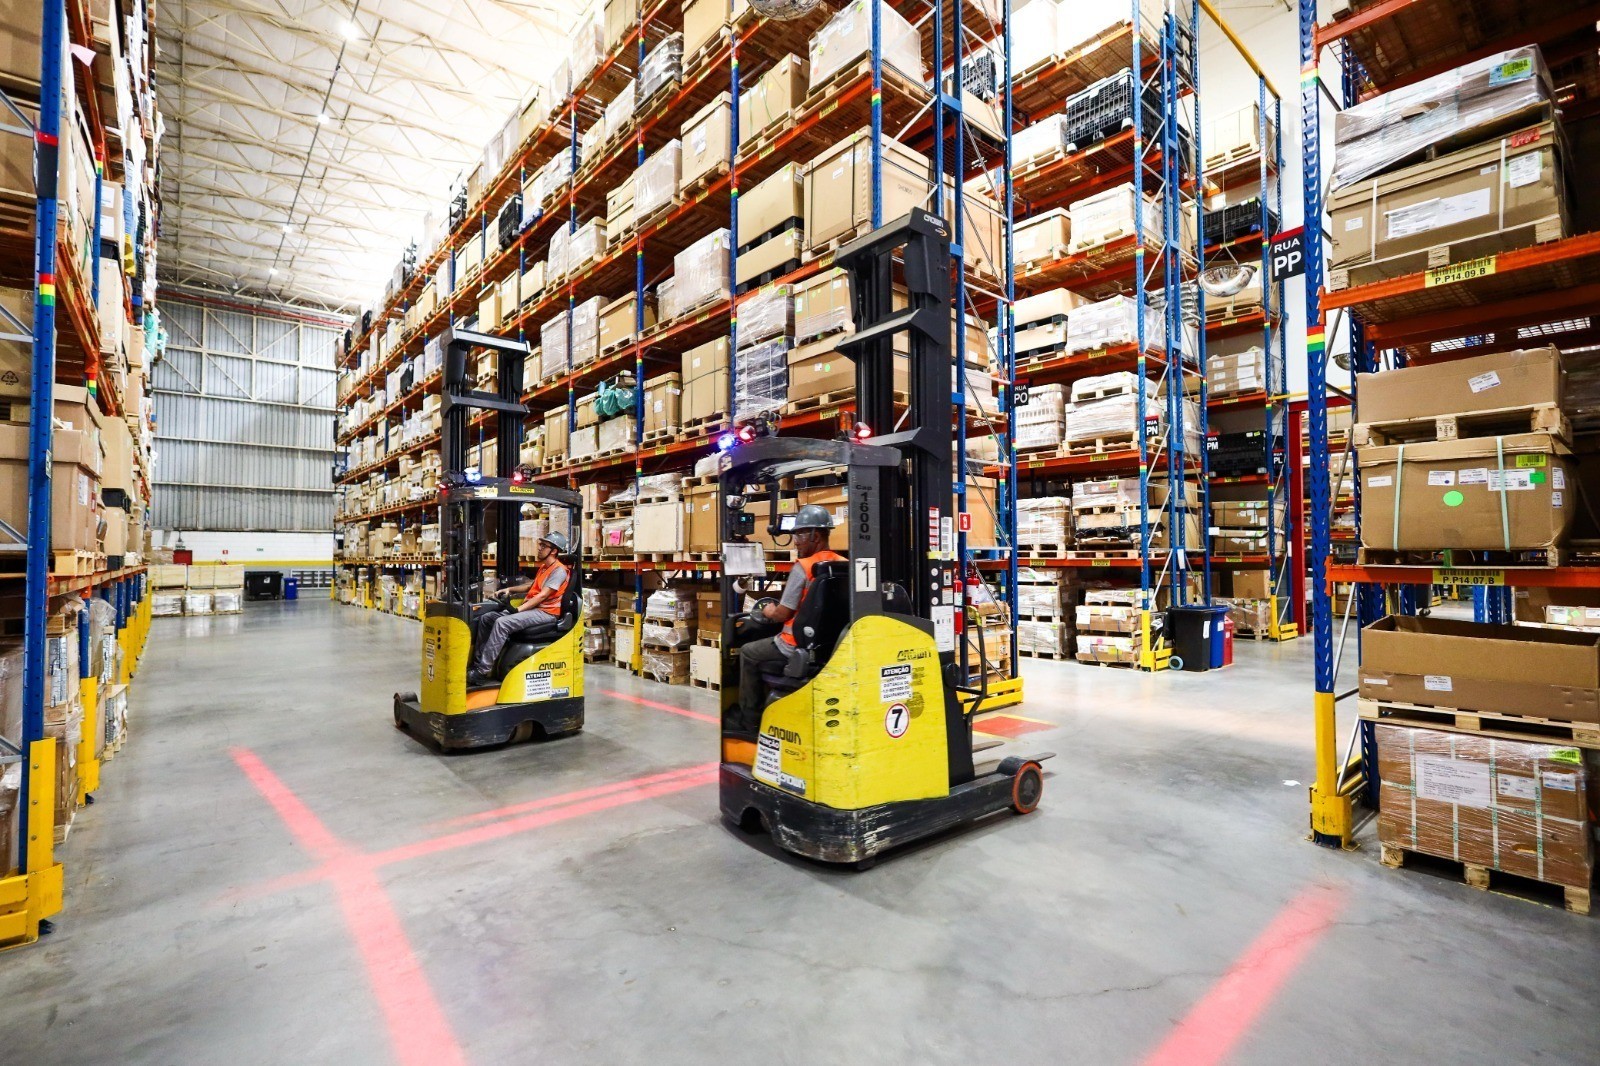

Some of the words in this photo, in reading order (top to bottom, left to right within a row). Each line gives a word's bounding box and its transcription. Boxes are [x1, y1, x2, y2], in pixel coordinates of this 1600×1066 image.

[1274, 237, 1300, 254] RUA
[1274, 250, 1302, 277] PP
[1014, 392, 1028, 404] PO
[1146, 425, 1158, 436] PN
[1206, 441, 1219, 451] PM
[1273, 456, 1284, 464] PL
[860, 491, 870, 533] 1600
[859, 533, 871, 541] kg
[861, 562, 870, 588] 1
[1442, 576, 1495, 585] P.P14.07.B
[883, 666, 910, 676] ATENÇÃO
[891, 708, 903, 729] 7
